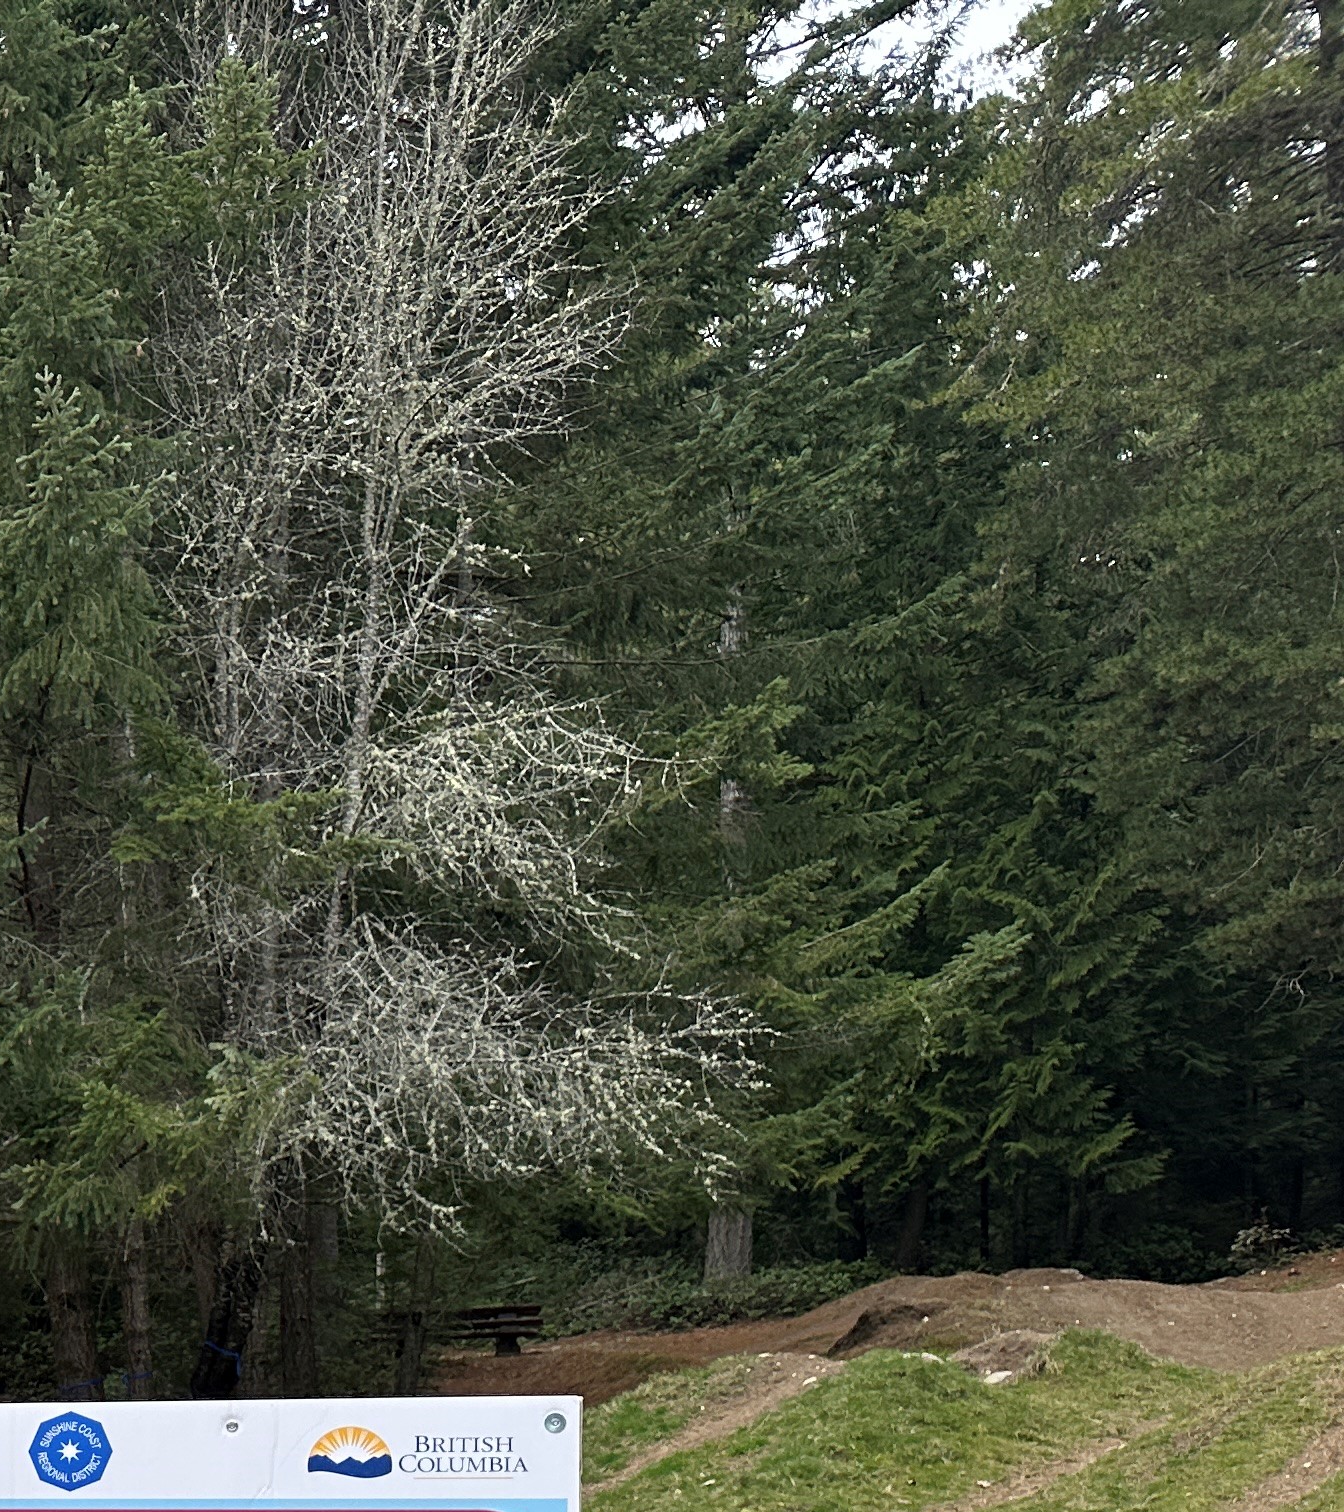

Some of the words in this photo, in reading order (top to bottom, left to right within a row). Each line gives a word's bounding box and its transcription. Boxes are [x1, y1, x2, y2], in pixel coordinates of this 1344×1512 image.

[40, 1421, 78, 1448] SUNSHINE
[79, 1423, 102, 1449] COAST
[414, 1434, 514, 1454] BRITISH
[37, 1451, 71, 1483] REGIONAL
[71, 1452, 103, 1483] DISTRICT
[398, 1453, 529, 1474] COLUMBIA
